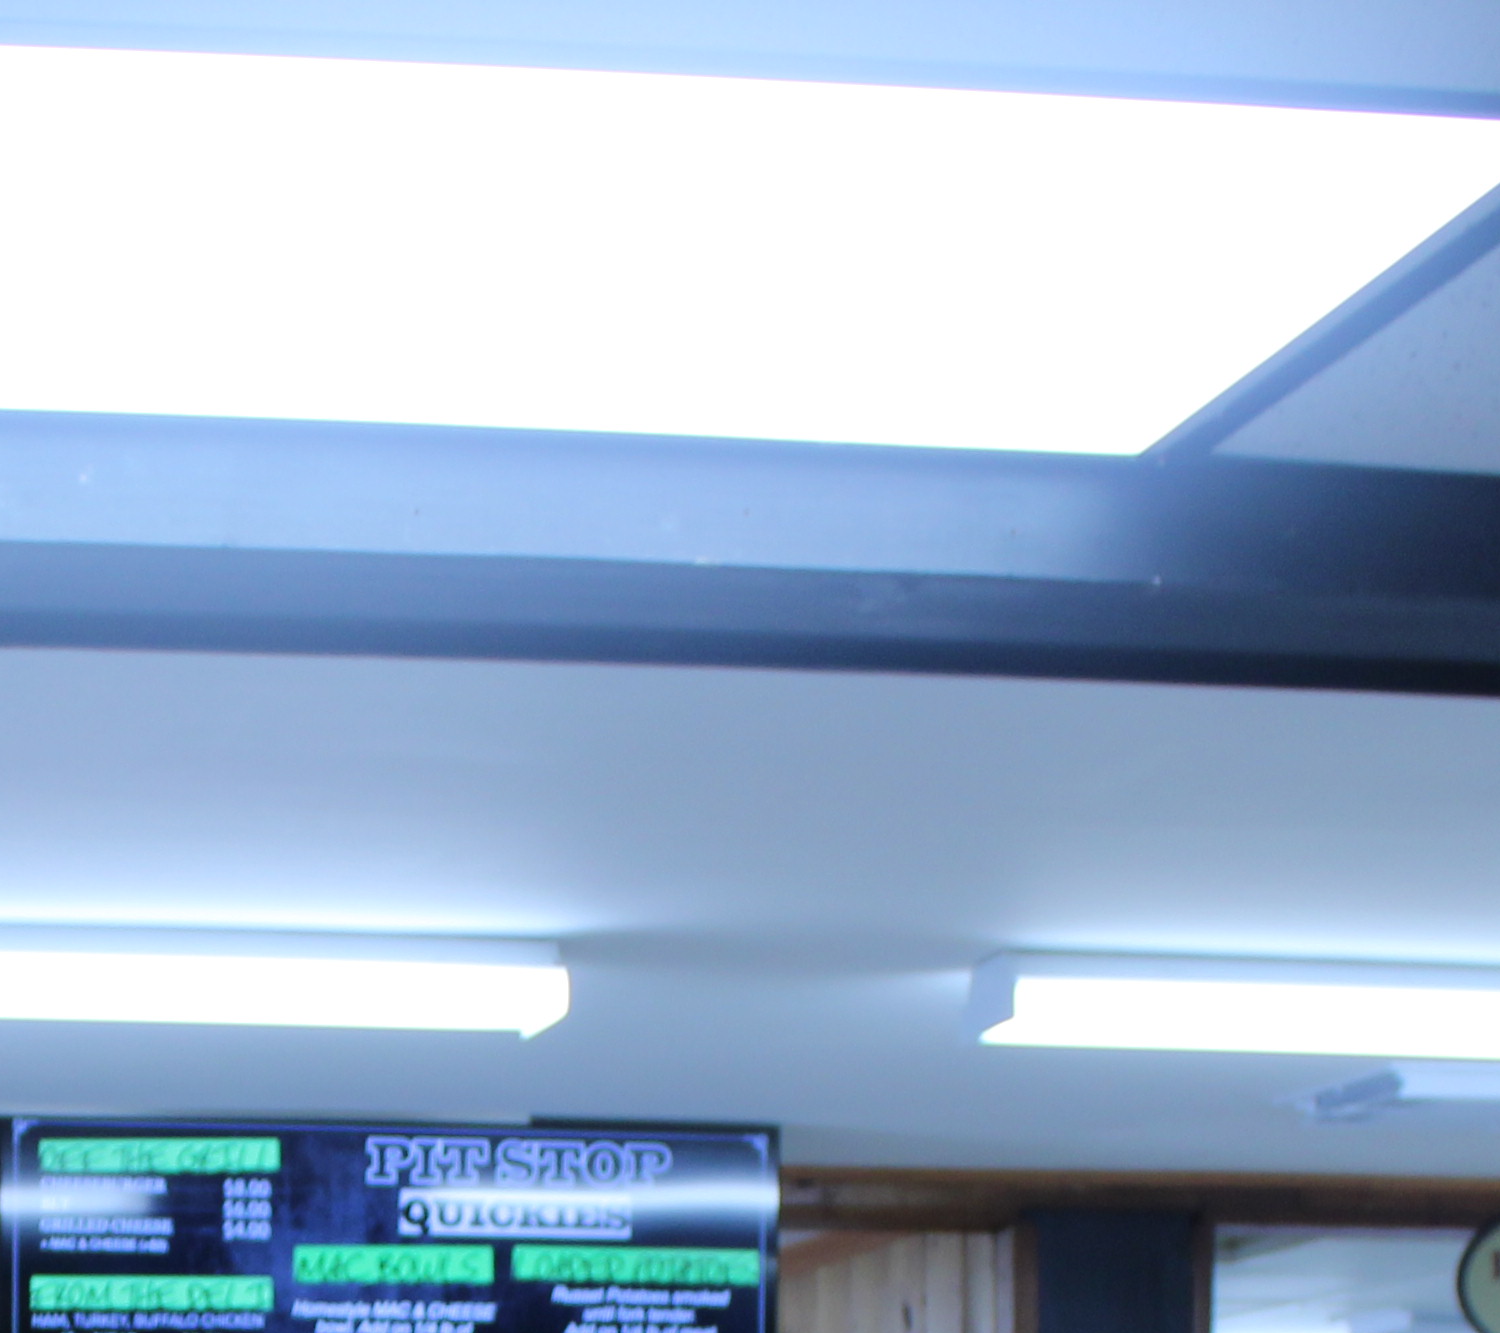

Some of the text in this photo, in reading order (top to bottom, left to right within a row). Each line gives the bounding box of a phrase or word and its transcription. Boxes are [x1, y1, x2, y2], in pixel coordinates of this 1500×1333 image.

[365, 1136, 673, 1189] PIT STOP
[403, 1202, 631, 1235] QUICKIES
[299, 1251, 481, 1279] MAC BOWLS
